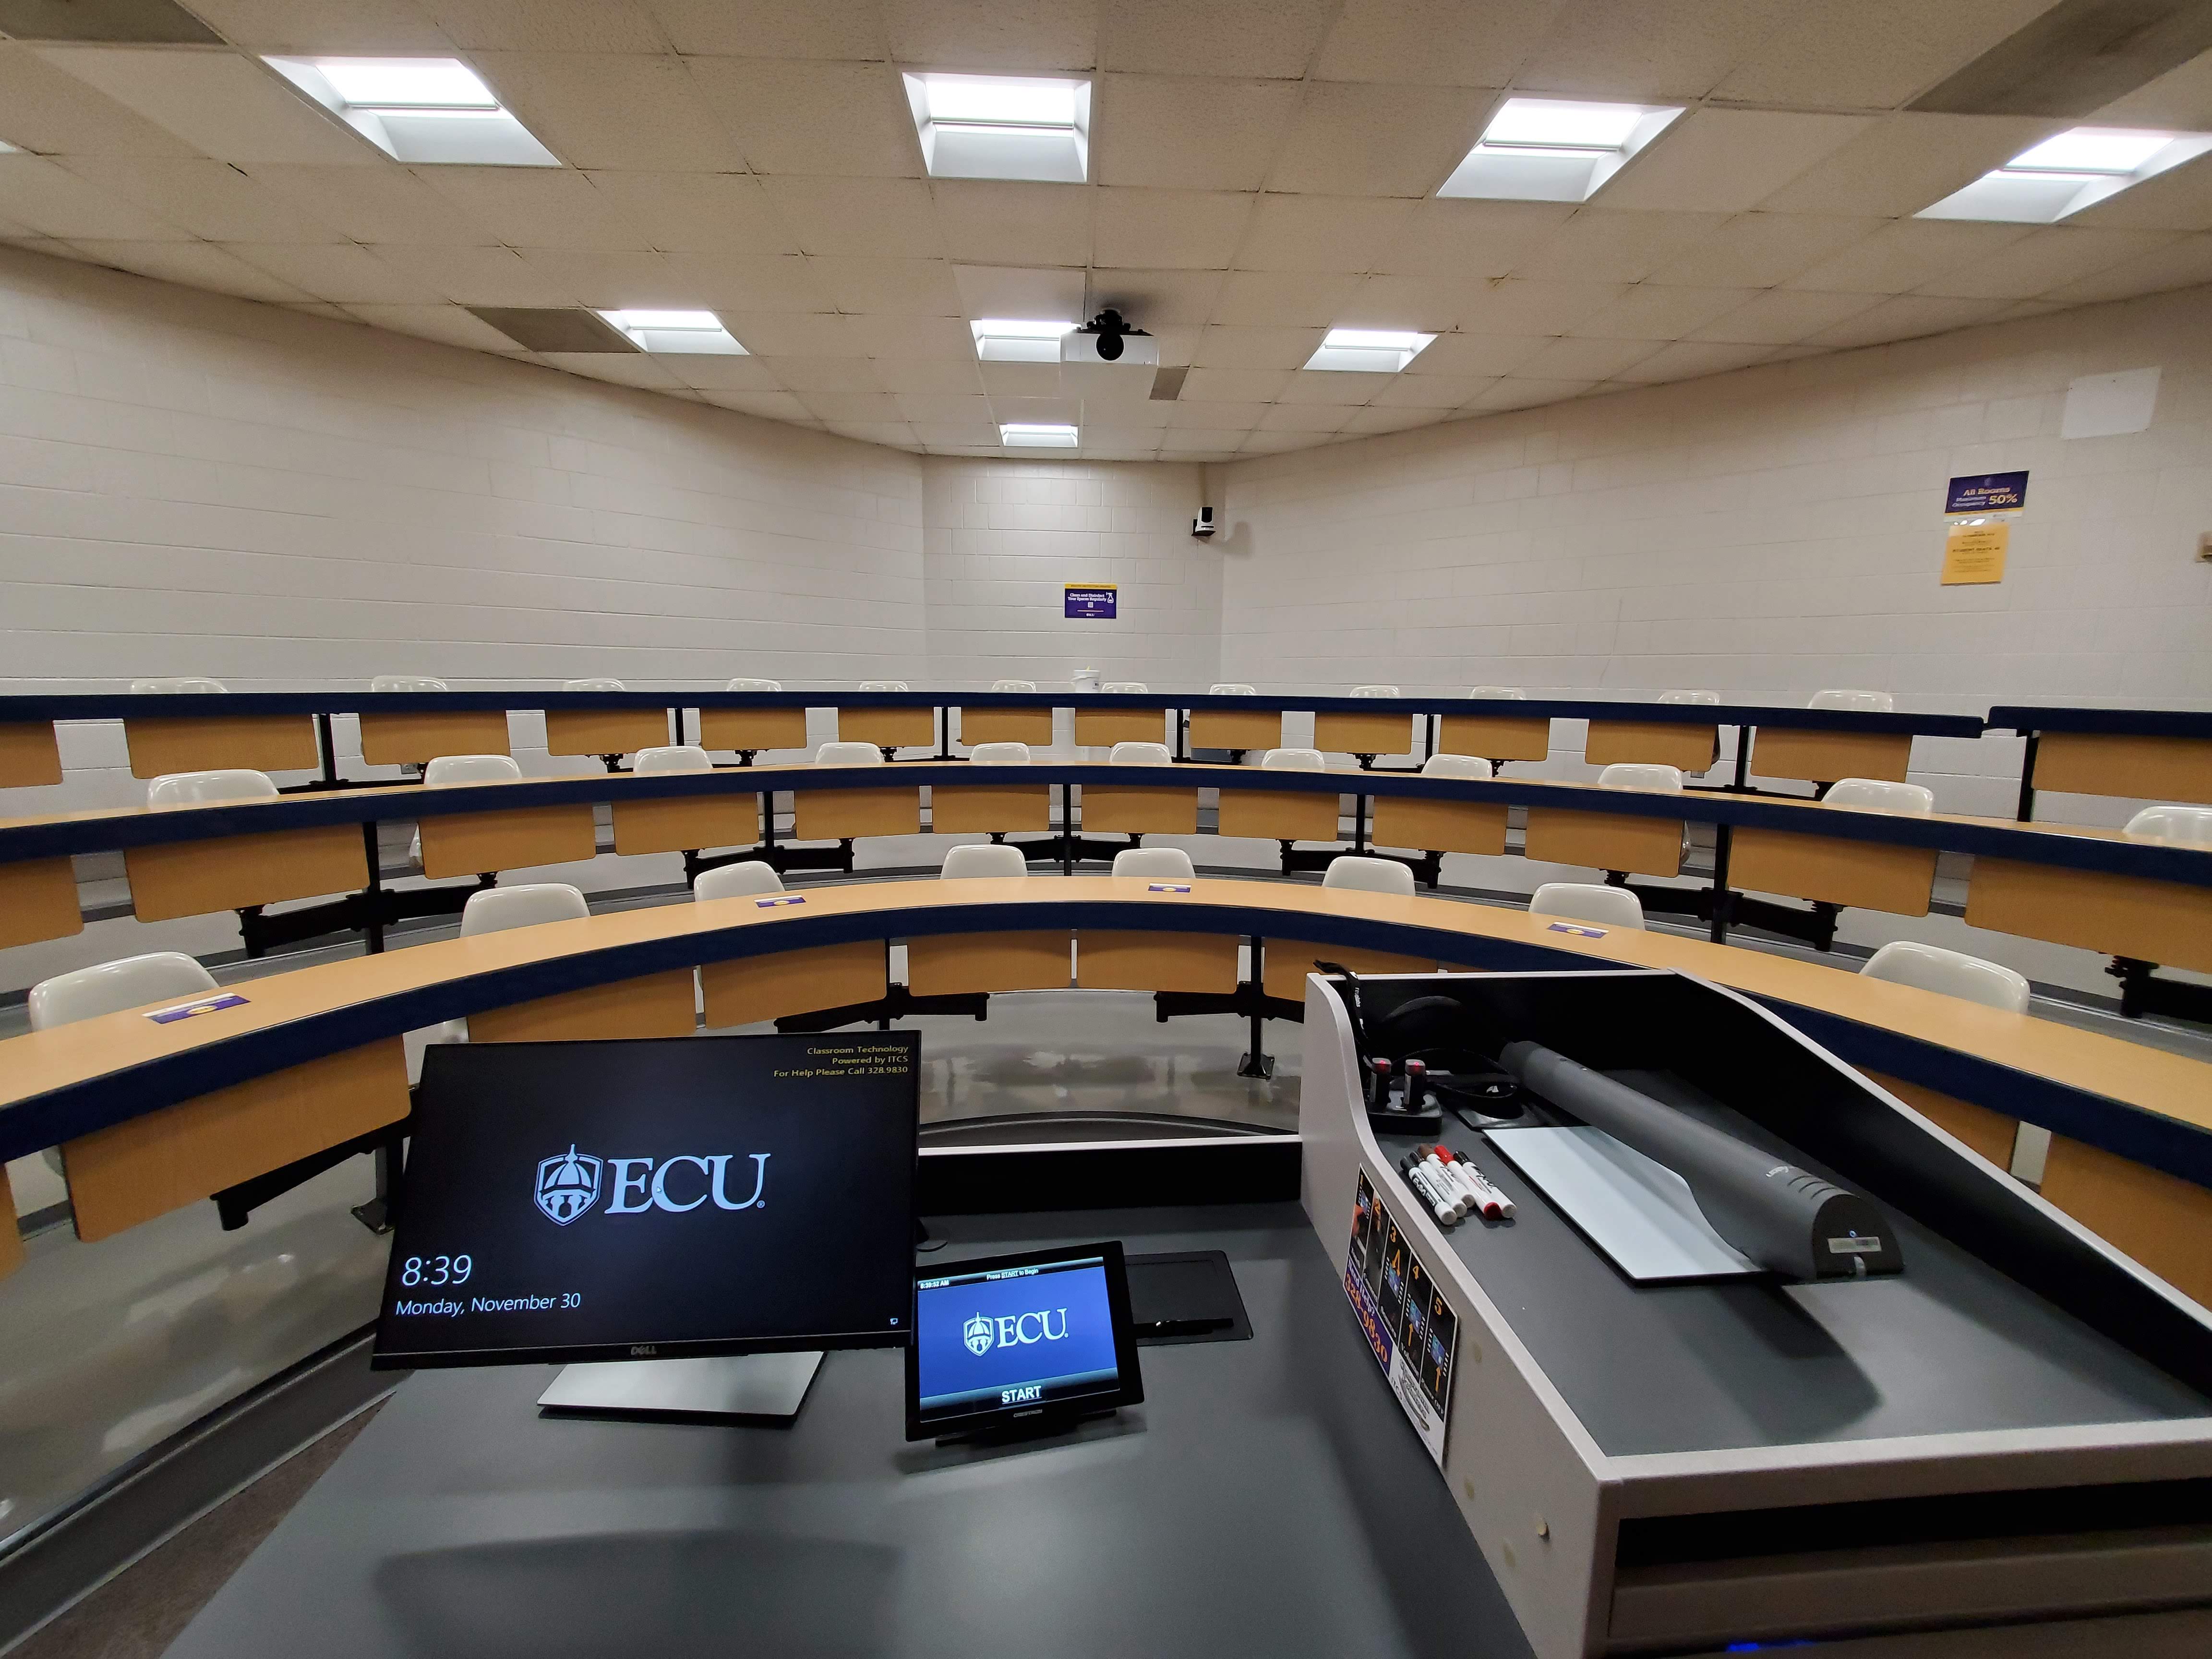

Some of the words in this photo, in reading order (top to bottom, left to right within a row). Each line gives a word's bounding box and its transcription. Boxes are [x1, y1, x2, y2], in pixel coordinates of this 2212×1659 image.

[1988, 493, 2018, 505] 50%
[857, 1045, 909, 1054] Technology
[832, 1056, 871, 1064] Powered
[875, 1056, 886, 1065] by
[792, 1070, 814, 1078] Help
[867, 1066, 908, 1074] 328.9830
[604, 1153, 771, 1214] ECU
[1390, 1226, 1397, 1243] 3
[401, 1254, 472, 1286] 8:39
[1412, 1265, 1419, 1280] 4
[920, 1281, 940, 1289] 8:39:52
[1347, 1258, 1360, 1287] Need
[1359, 1283, 1375, 1317] Help?
[396, 1298, 465, 1317] Monday,
[471, 1294, 557, 1312] November
[560, 1293, 581, 1309] 30
[1434, 1296, 1443, 1316] 5
[1345, 1273, 1388, 1363] 328-9830
[994, 1308, 1068, 1348] ECU
[631, 1346, 657, 1355] DELL
[1001, 1385, 1042, 1403] START
